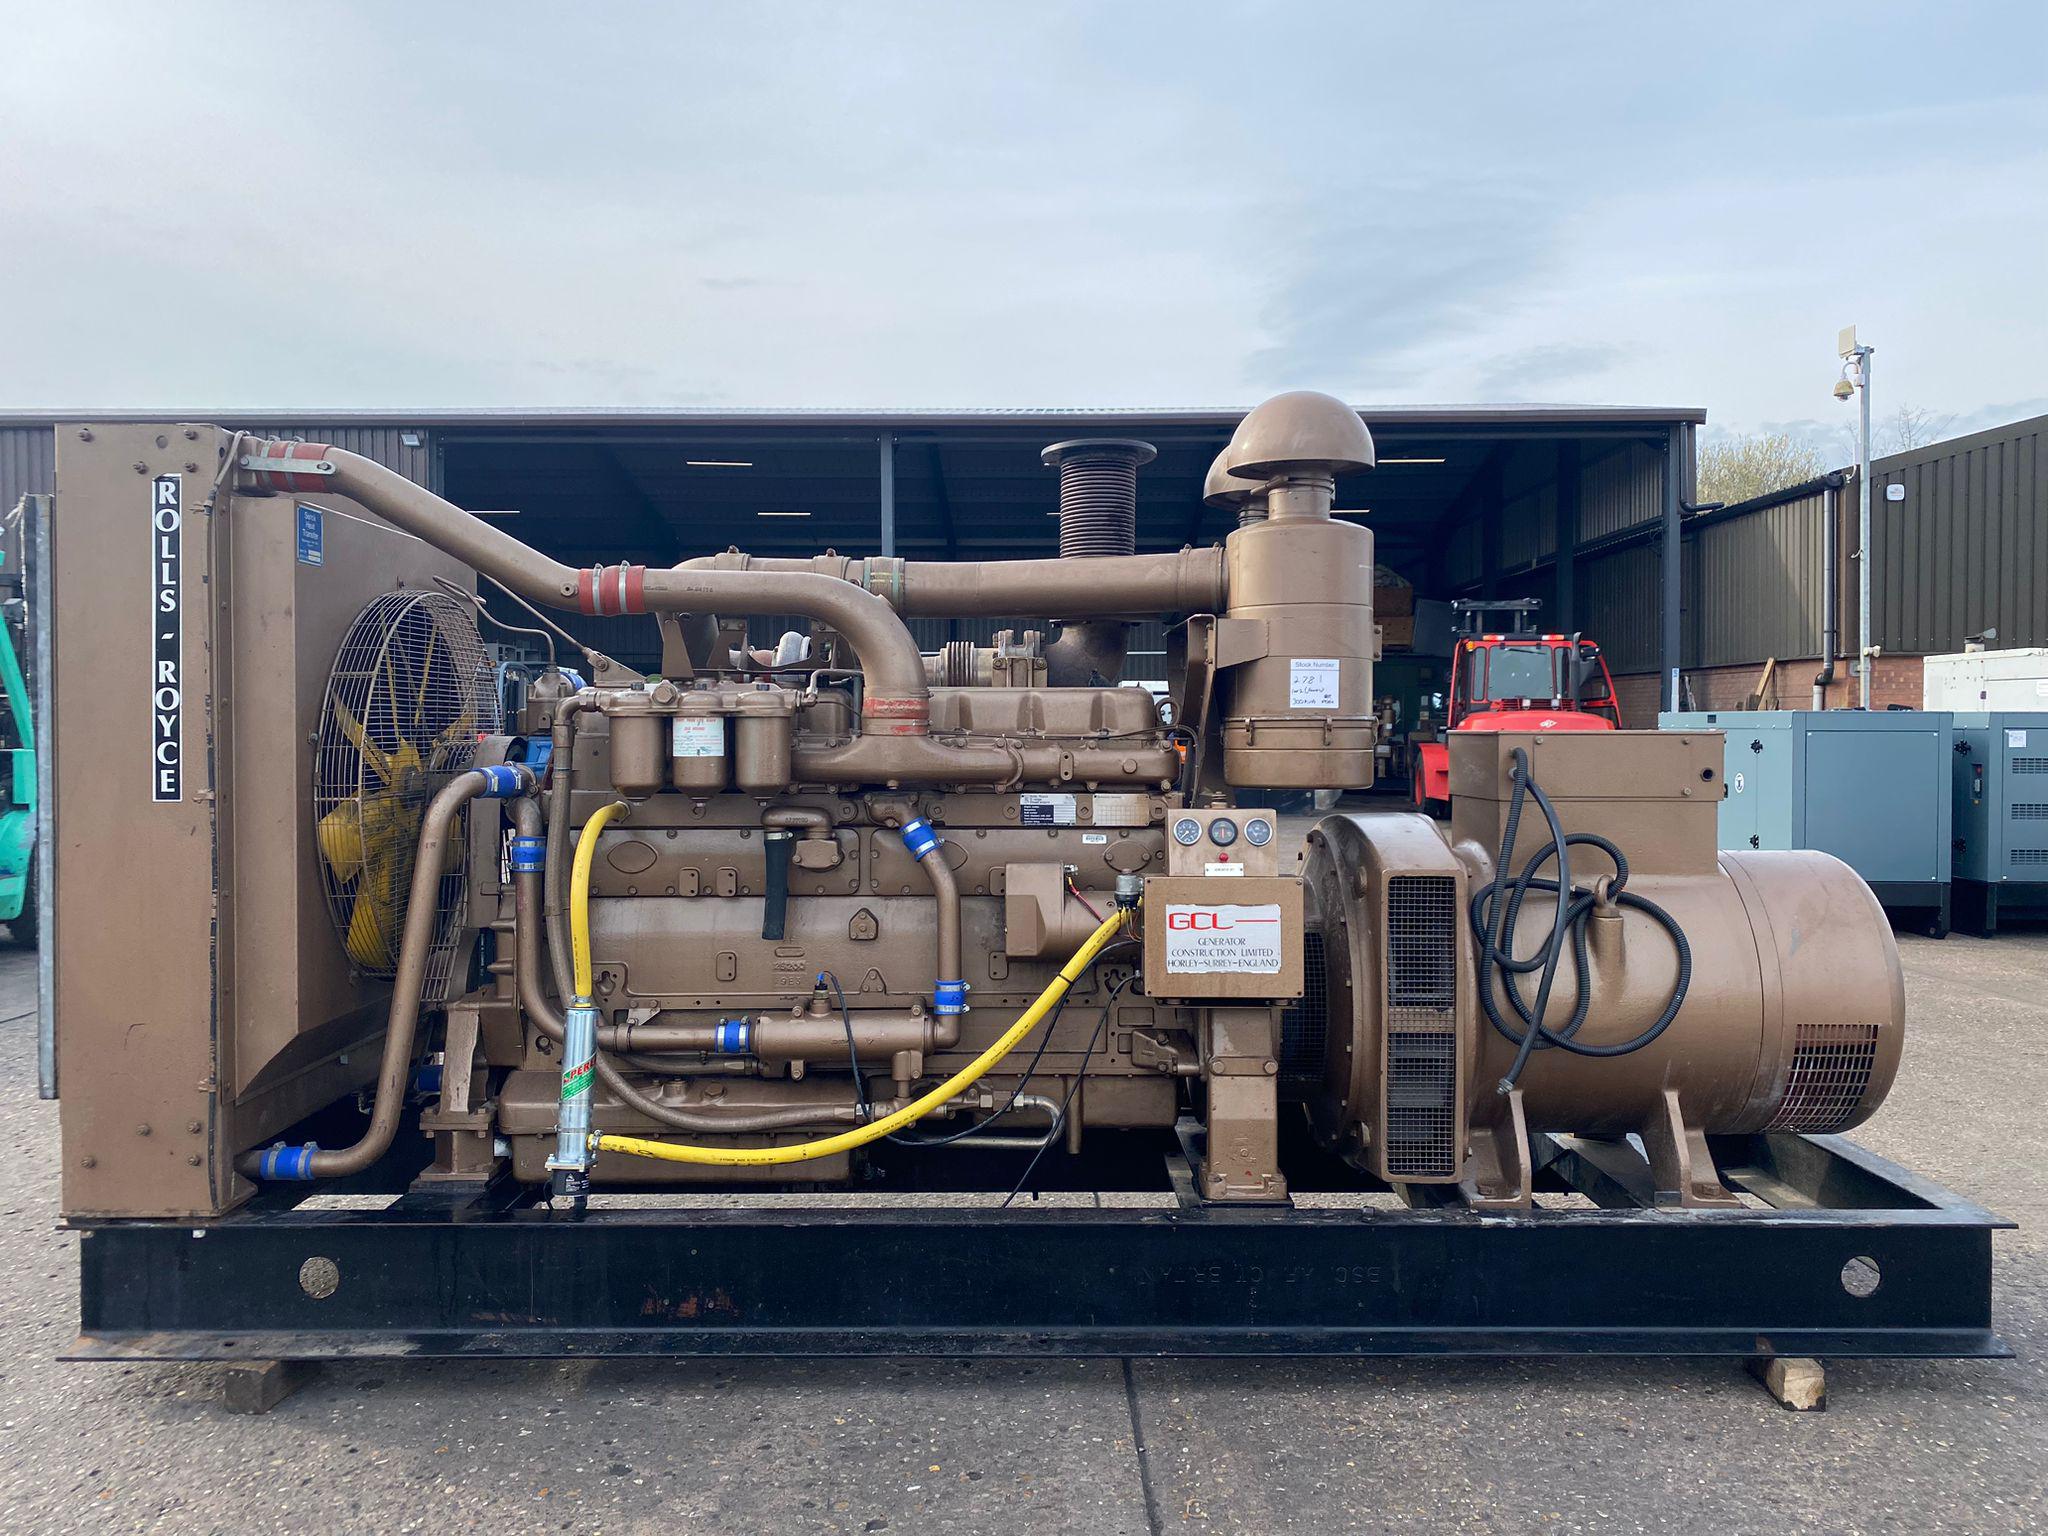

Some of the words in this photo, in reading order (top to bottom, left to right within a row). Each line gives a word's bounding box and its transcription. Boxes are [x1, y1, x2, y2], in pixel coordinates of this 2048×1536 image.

[1168, 911, 1234, 931] GCL
[1197, 937, 1247, 946] GENERATOR
[1171, 948, 1237, 957] CONSTRUCTION
[1241, 948, 1274, 957] LIMITED
